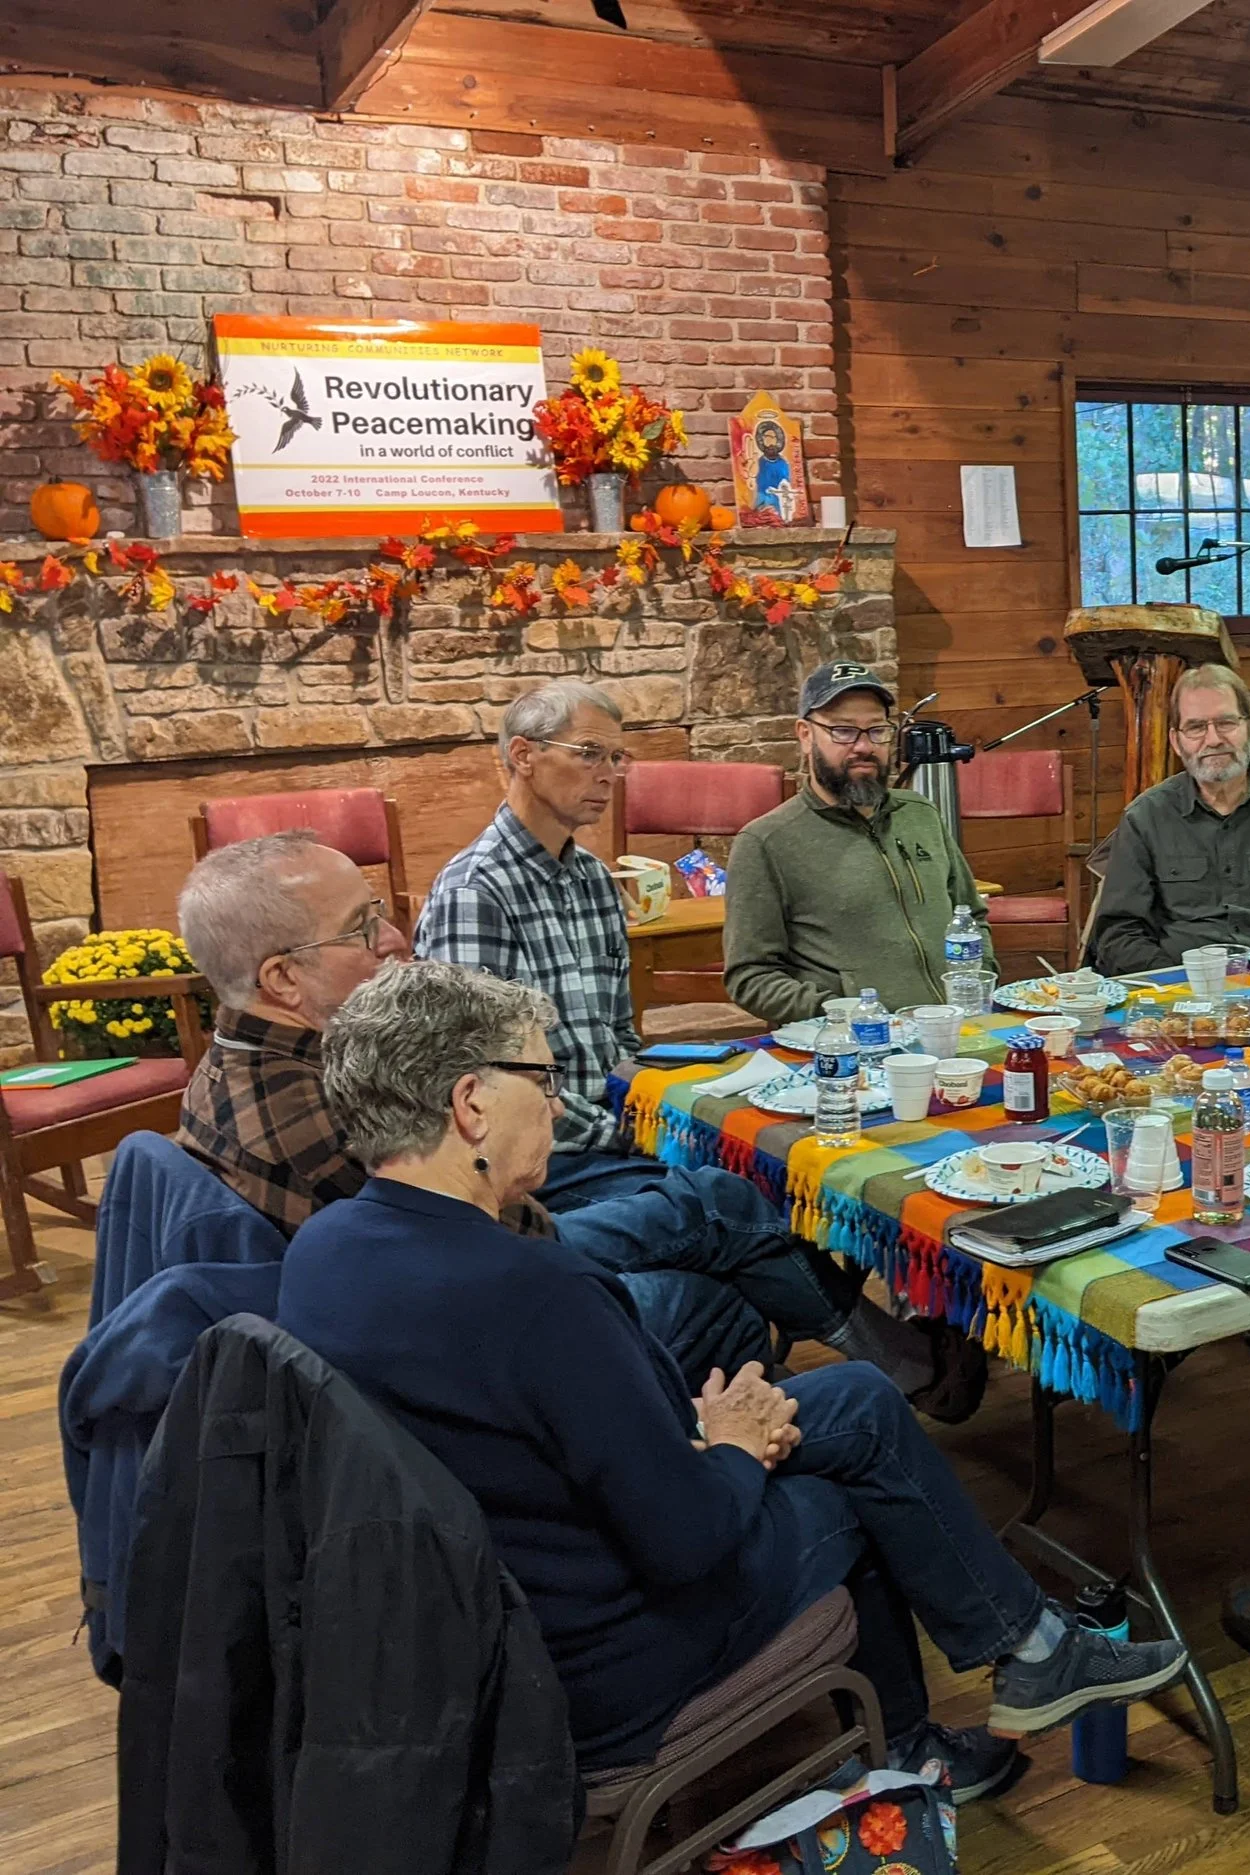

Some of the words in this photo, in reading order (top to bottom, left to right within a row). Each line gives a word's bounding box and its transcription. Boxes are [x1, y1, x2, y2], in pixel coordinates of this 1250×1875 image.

[260, 342, 339, 353] NURTURING
[347, 344, 440, 355] COMMUNITIES
[445, 347, 504, 357] NETWORK
[324, 376, 534, 408] Revolutionary
[331, 411, 535, 441] Peacemaking
[360, 444, 375, 457] in
[378, 447, 387, 457] a
[390, 445, 435, 458] world
[438, 445, 453, 458] of
[456, 445, 514, 458] conflict
[311, 475, 340, 484] 2022
[343, 475, 418, 484] International
[420, 475, 484, 483] Conference
[285, 489, 332, 498] October
[336, 489, 361, 497] 7-10
[375, 489, 408, 498] Camp
[411, 489, 456, 498] Loucon,
[458, 488, 510, 498] Kentucky
[831, 663, 869, 681] P
